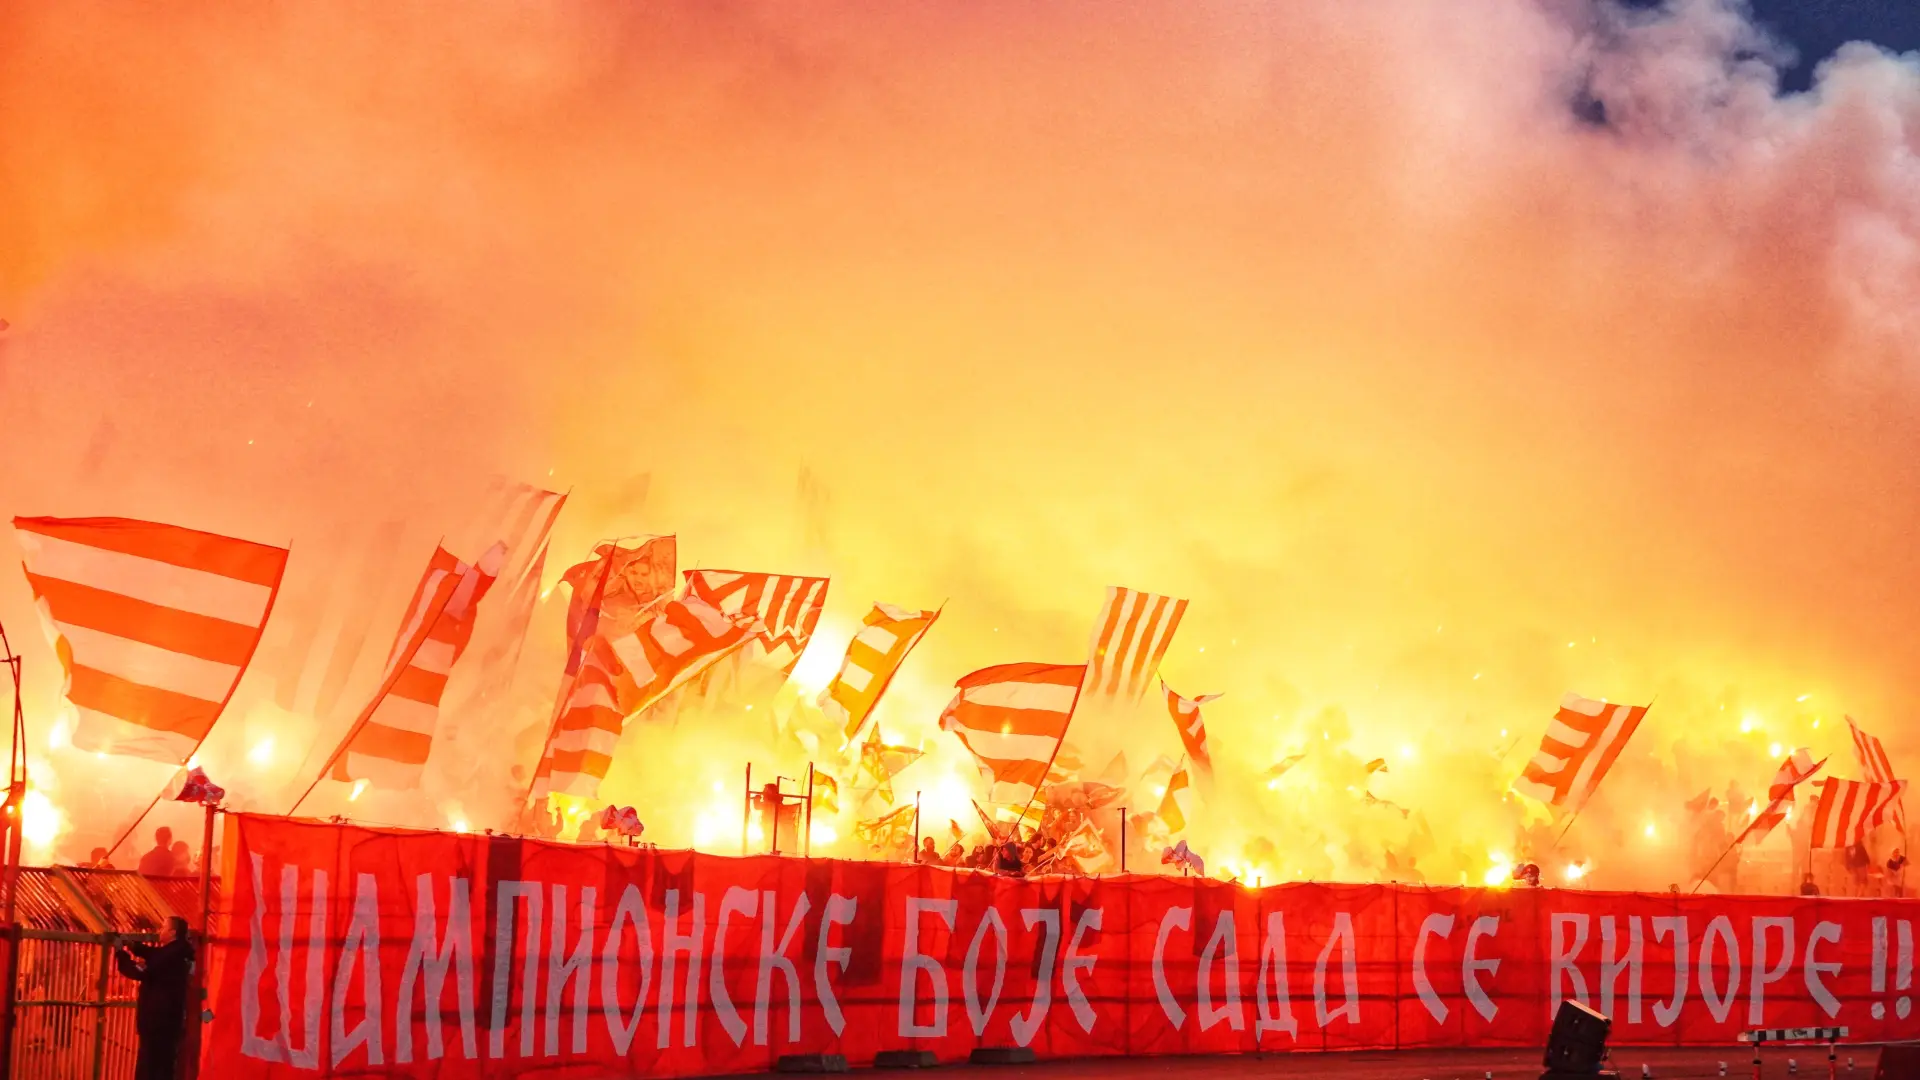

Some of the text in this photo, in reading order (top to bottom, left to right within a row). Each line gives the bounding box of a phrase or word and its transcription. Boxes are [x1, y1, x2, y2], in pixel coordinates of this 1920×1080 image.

[240, 852, 858, 1071] ШАМПИОНСКЕ
[898, 897, 1103, 1047] БОЈЕ
[1152, 905, 1361, 1043] САДА
[1413, 912, 1501, 1025] СЕ
